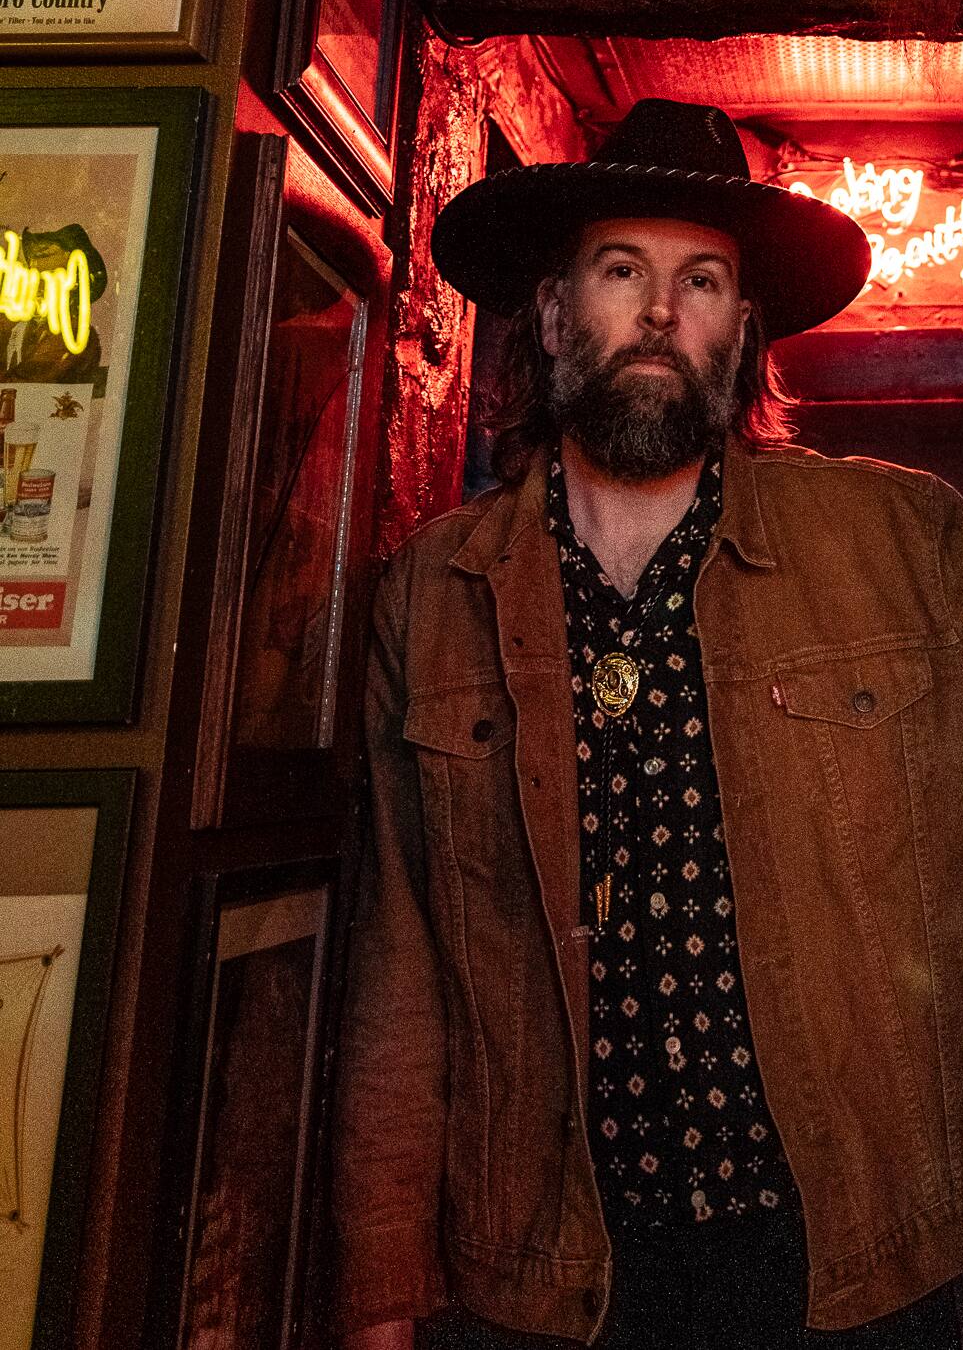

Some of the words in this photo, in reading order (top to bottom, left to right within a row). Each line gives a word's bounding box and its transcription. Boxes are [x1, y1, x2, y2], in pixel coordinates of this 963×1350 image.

[8, 17, 26, 25] Filter
[32, 16, 44, 25] You
[45, 17, 56, 26] get
[64, 17, 73, 25] lot
[83, 17, 96, 25] like
